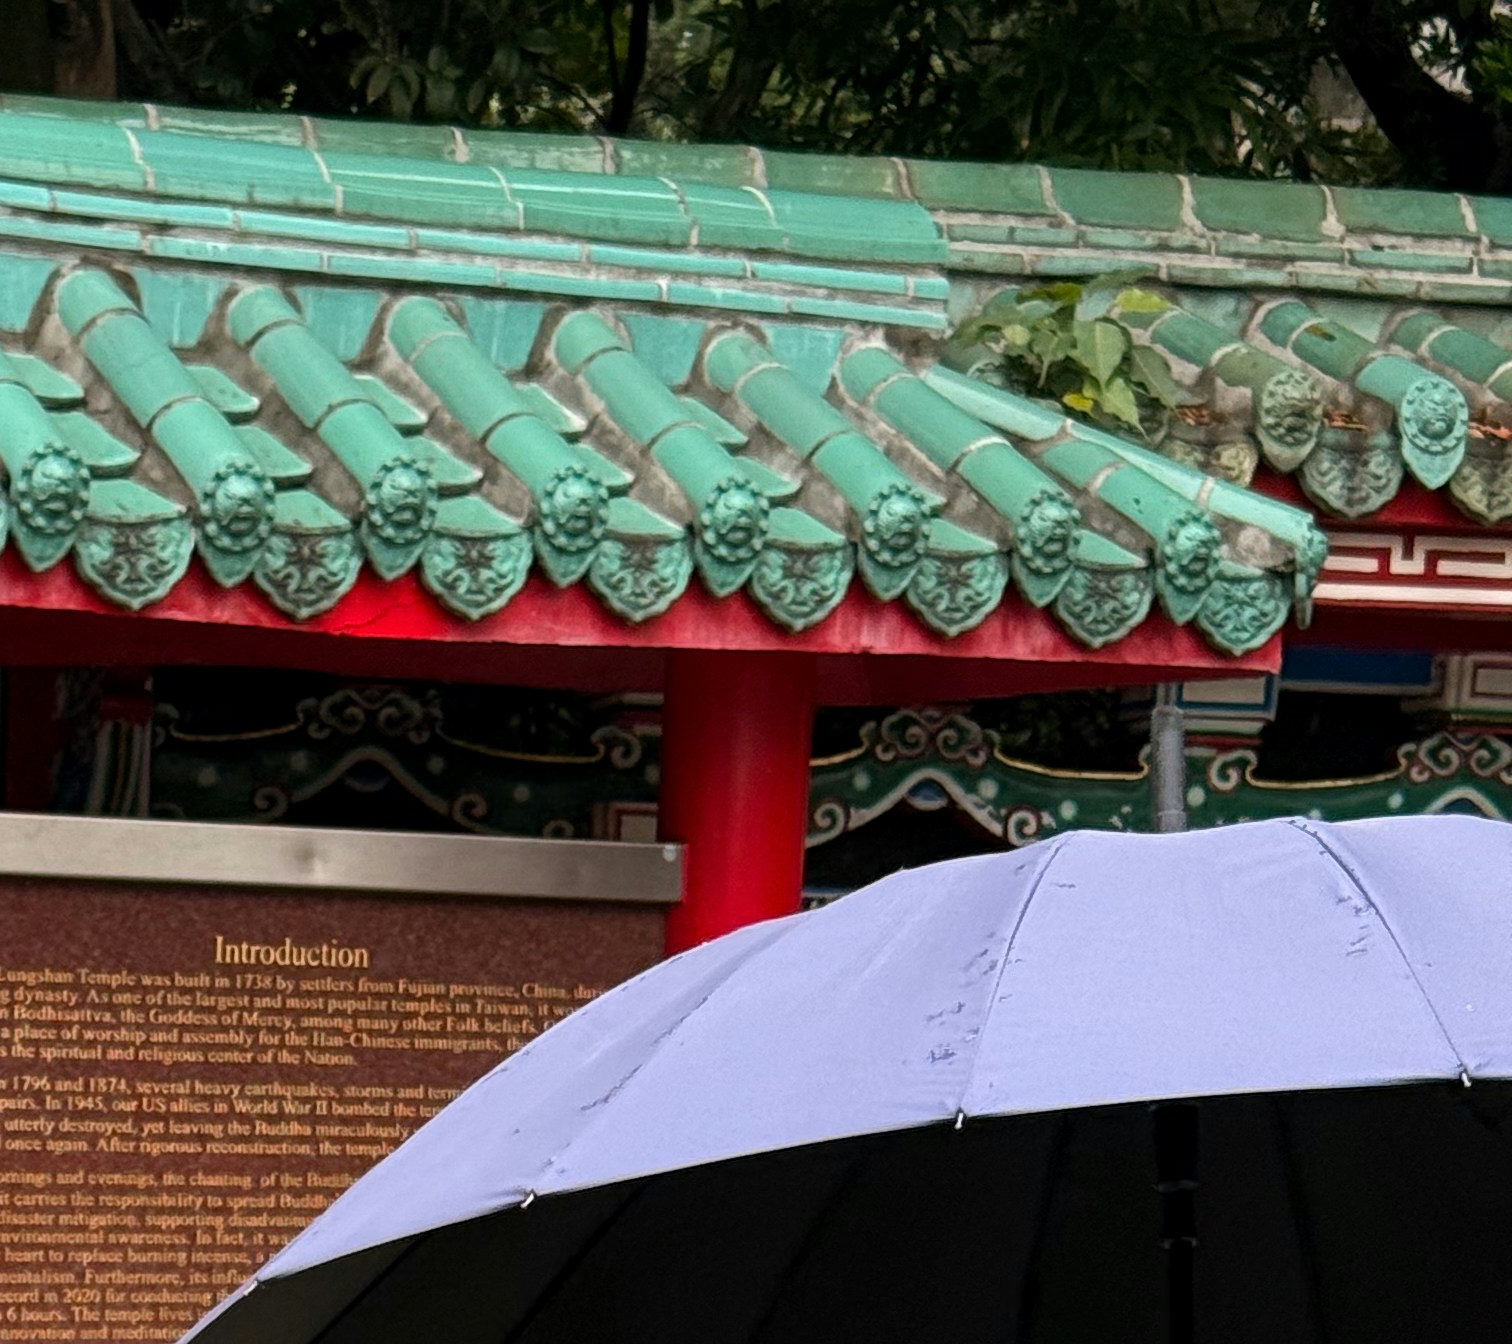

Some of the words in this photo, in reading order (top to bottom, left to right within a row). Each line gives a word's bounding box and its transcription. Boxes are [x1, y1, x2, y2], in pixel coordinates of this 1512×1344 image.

[215, 935, 369, 968] Introduction
[80, 968, 136, 989] Temple
[140, 975, 170, 986] was
[174, 971, 210, 987] built
[236, 973, 271, 989] 1738
[300, 975, 353, 991] settlers
[358, 977, 394, 993] from
[398, 978, 445, 998] Fujian
[112, 993, 140, 1004] one
[166, 989, 190, 1005] the
[196, 990, 248, 1010] largest
[254, 992, 281, 1007] and
[286, 992, 323, 1008] most
[328, 994, 386, 1014] popular
[391, 995, 450, 1016] temples
[476, 997, 532, 1016] Taiwan,
[120, 1007, 144, 1023] the
[149, 1008, 216, 1024] Goddess
[242, 1010, 294, 1030] Mercy,
[301, 1016, 352, 1031] among
[357, 1017, 397, 1032] many
[402, 1013, 440, 1029] other
[446, 1014, 478, 1030] Folk
[14, 1023, 55, 1043] place
[83, 1025, 146, 1045] worship
[150, 1026, 177, 1042] and
[182, 1027, 251, 1047] assembly
[258, 1028, 279, 1044] for
[284, 1029, 307, 1044] the
[313, 1030, 410, 1047] Han-Chinese
[10, 1042, 35, 1057] the
[39, 1042, 102, 1063] spiritual
[106, 1044, 134, 1059] and
[138, 1044, 204, 1065] religious
[207, 1046, 253, 1062] center
[277, 1047, 300, 1063] the
[304, 1048, 356, 1064] Nation.
[13, 1075, 51, 1090] 1796
[54, 1075, 83, 1091] and
[89, 1076, 130, 1093] 1874,
[136, 1077, 190, 1092] several
[194, 1078, 240, 1097] heavy
[244, 1078, 337, 1099] earthquakes,
[344, 1080, 393, 1096] storms
[397, 1081, 424, 1096] and
[68, 1094, 105, 1112] 1945,
[112, 1100, 137, 1110] our
[142, 1095, 166, 1110] US
[232, 1096, 277, 1112] World
[282, 1097, 310, 1113] War
[316, 1098, 327, 1113] II
[332, 1098, 389, 1114] bombed
[393, 1099, 414, 1114] the
[4, 1115, 54, 1135] utterly
[142, 1117, 164, 1136] yet
[169, 1118, 223, 1137] leaving
[227, 1118, 250, 1134] the
[255, 1119, 311, 1135] Buddha
[4, 1139, 41, 1150] once
[96, 1135, 135, 1151] After
[319, 1138, 341, 1154] the
[345, 1139, 396, 1158] temple
[56, 1169, 84, 1184] and
[162, 1170, 184, 1185] the
[280, 1171, 302, 1186] the
[14, 1189, 66, 1204] carries
[71, 1190, 93, 1205] the
[99, 1190, 202, 1210] responsibility
[228, 1191, 275, 1210] spread
[5, 1247, 43, 1262] heart
[128, 1248, 186, 1267] burning
[63, 1287, 100, 1302] 2020
[106, 1287, 124, 1302] for
[21, 1306, 65, 1320] hours.
[73, 1306, 99, 1320] The
[104, 1306, 153, 1324] temple
[159, 1306, 192, 1320] lives
[80, 1324, 108, 1339] and
